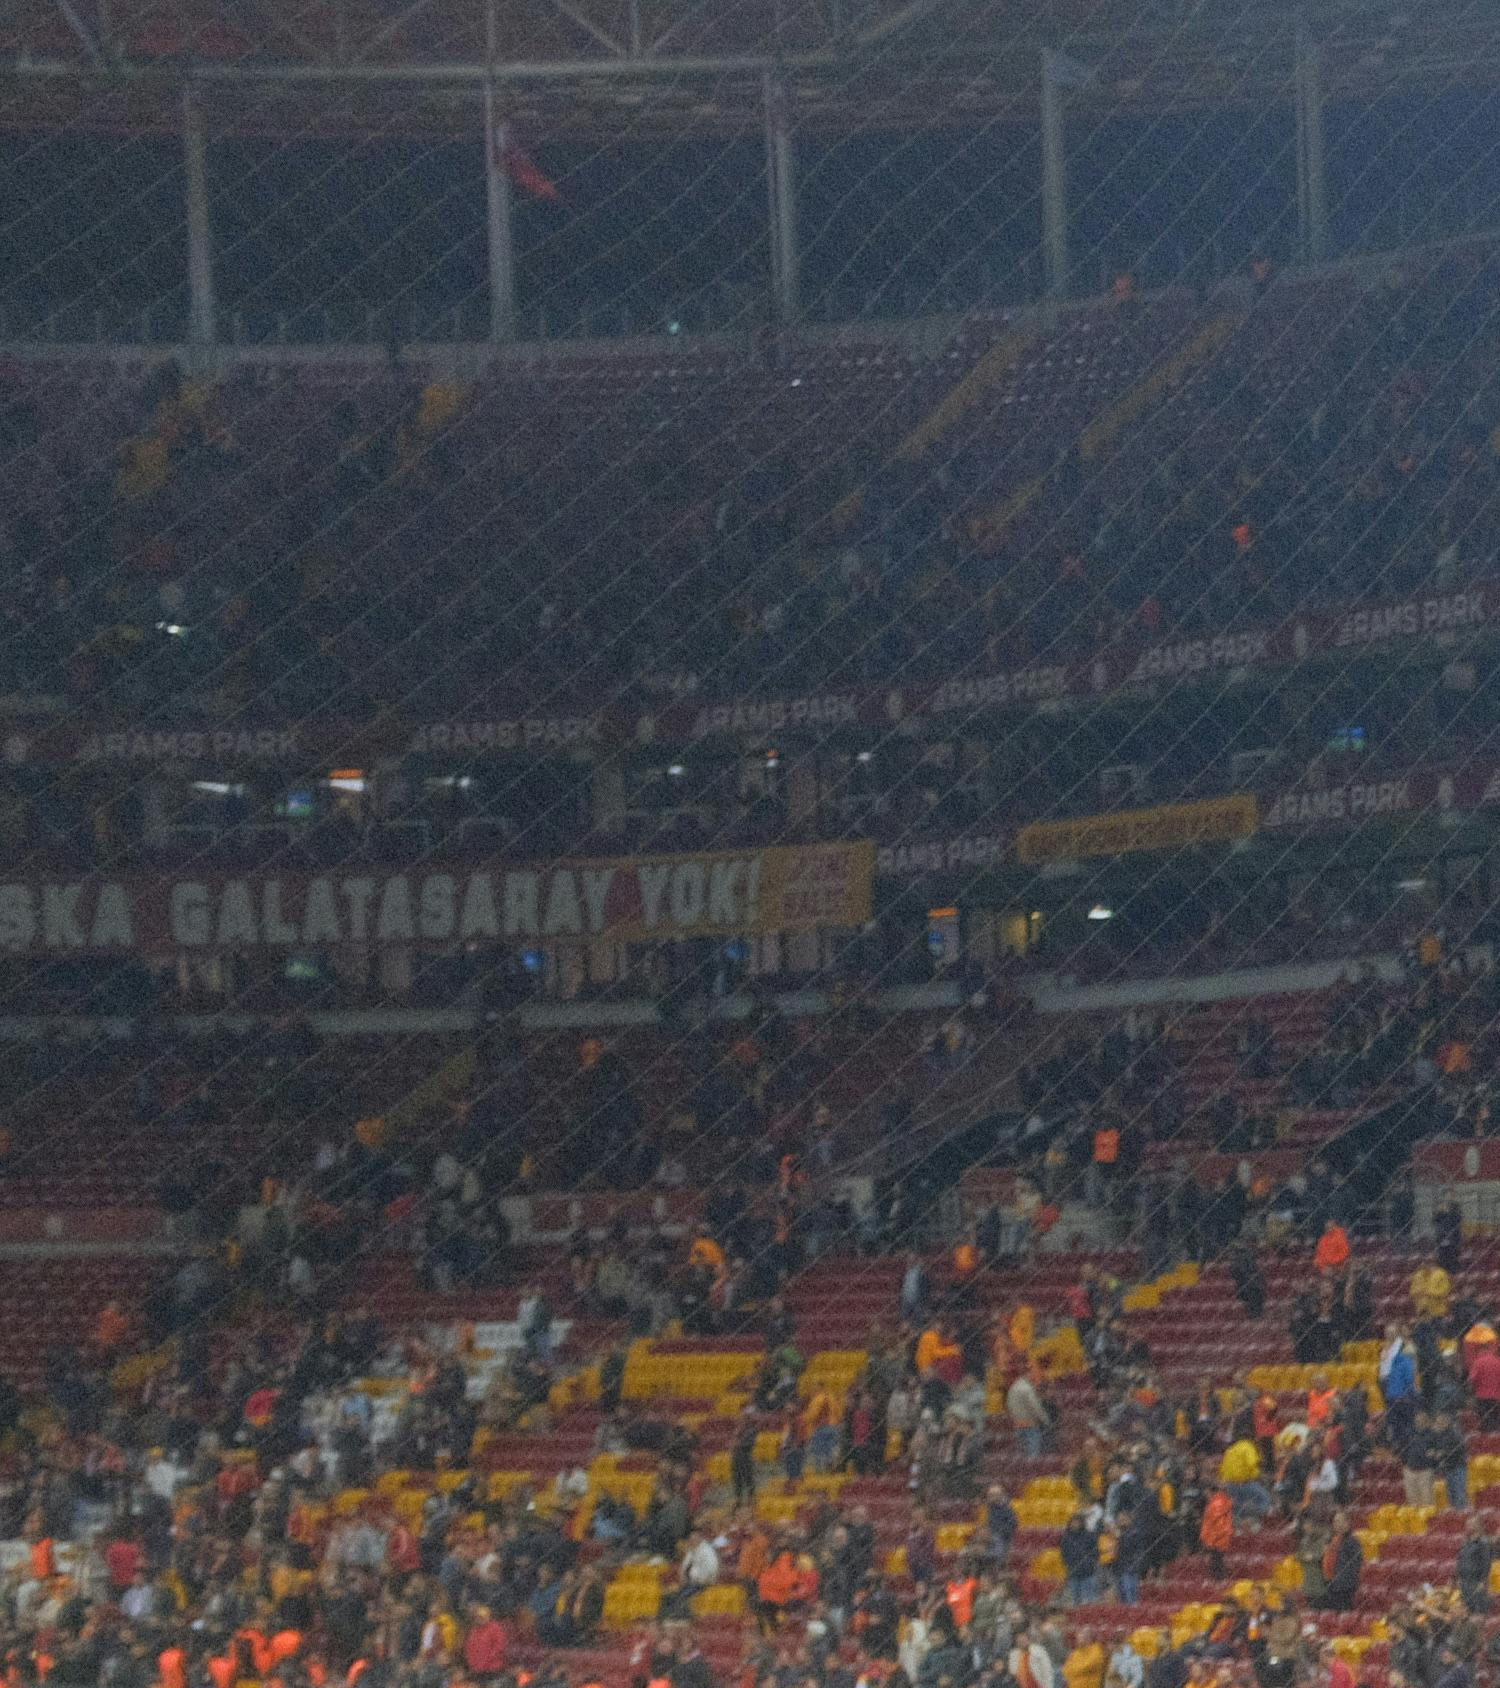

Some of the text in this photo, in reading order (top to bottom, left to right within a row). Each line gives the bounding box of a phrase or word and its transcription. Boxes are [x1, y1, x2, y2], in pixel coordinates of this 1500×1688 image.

[1352, 593, 1484, 641] RAMS PARK
[1282, 780, 1411, 822] RAMS PARK
[170, 866, 617, 946] GALATASARAY
[637, 856, 763, 928] YOK!
